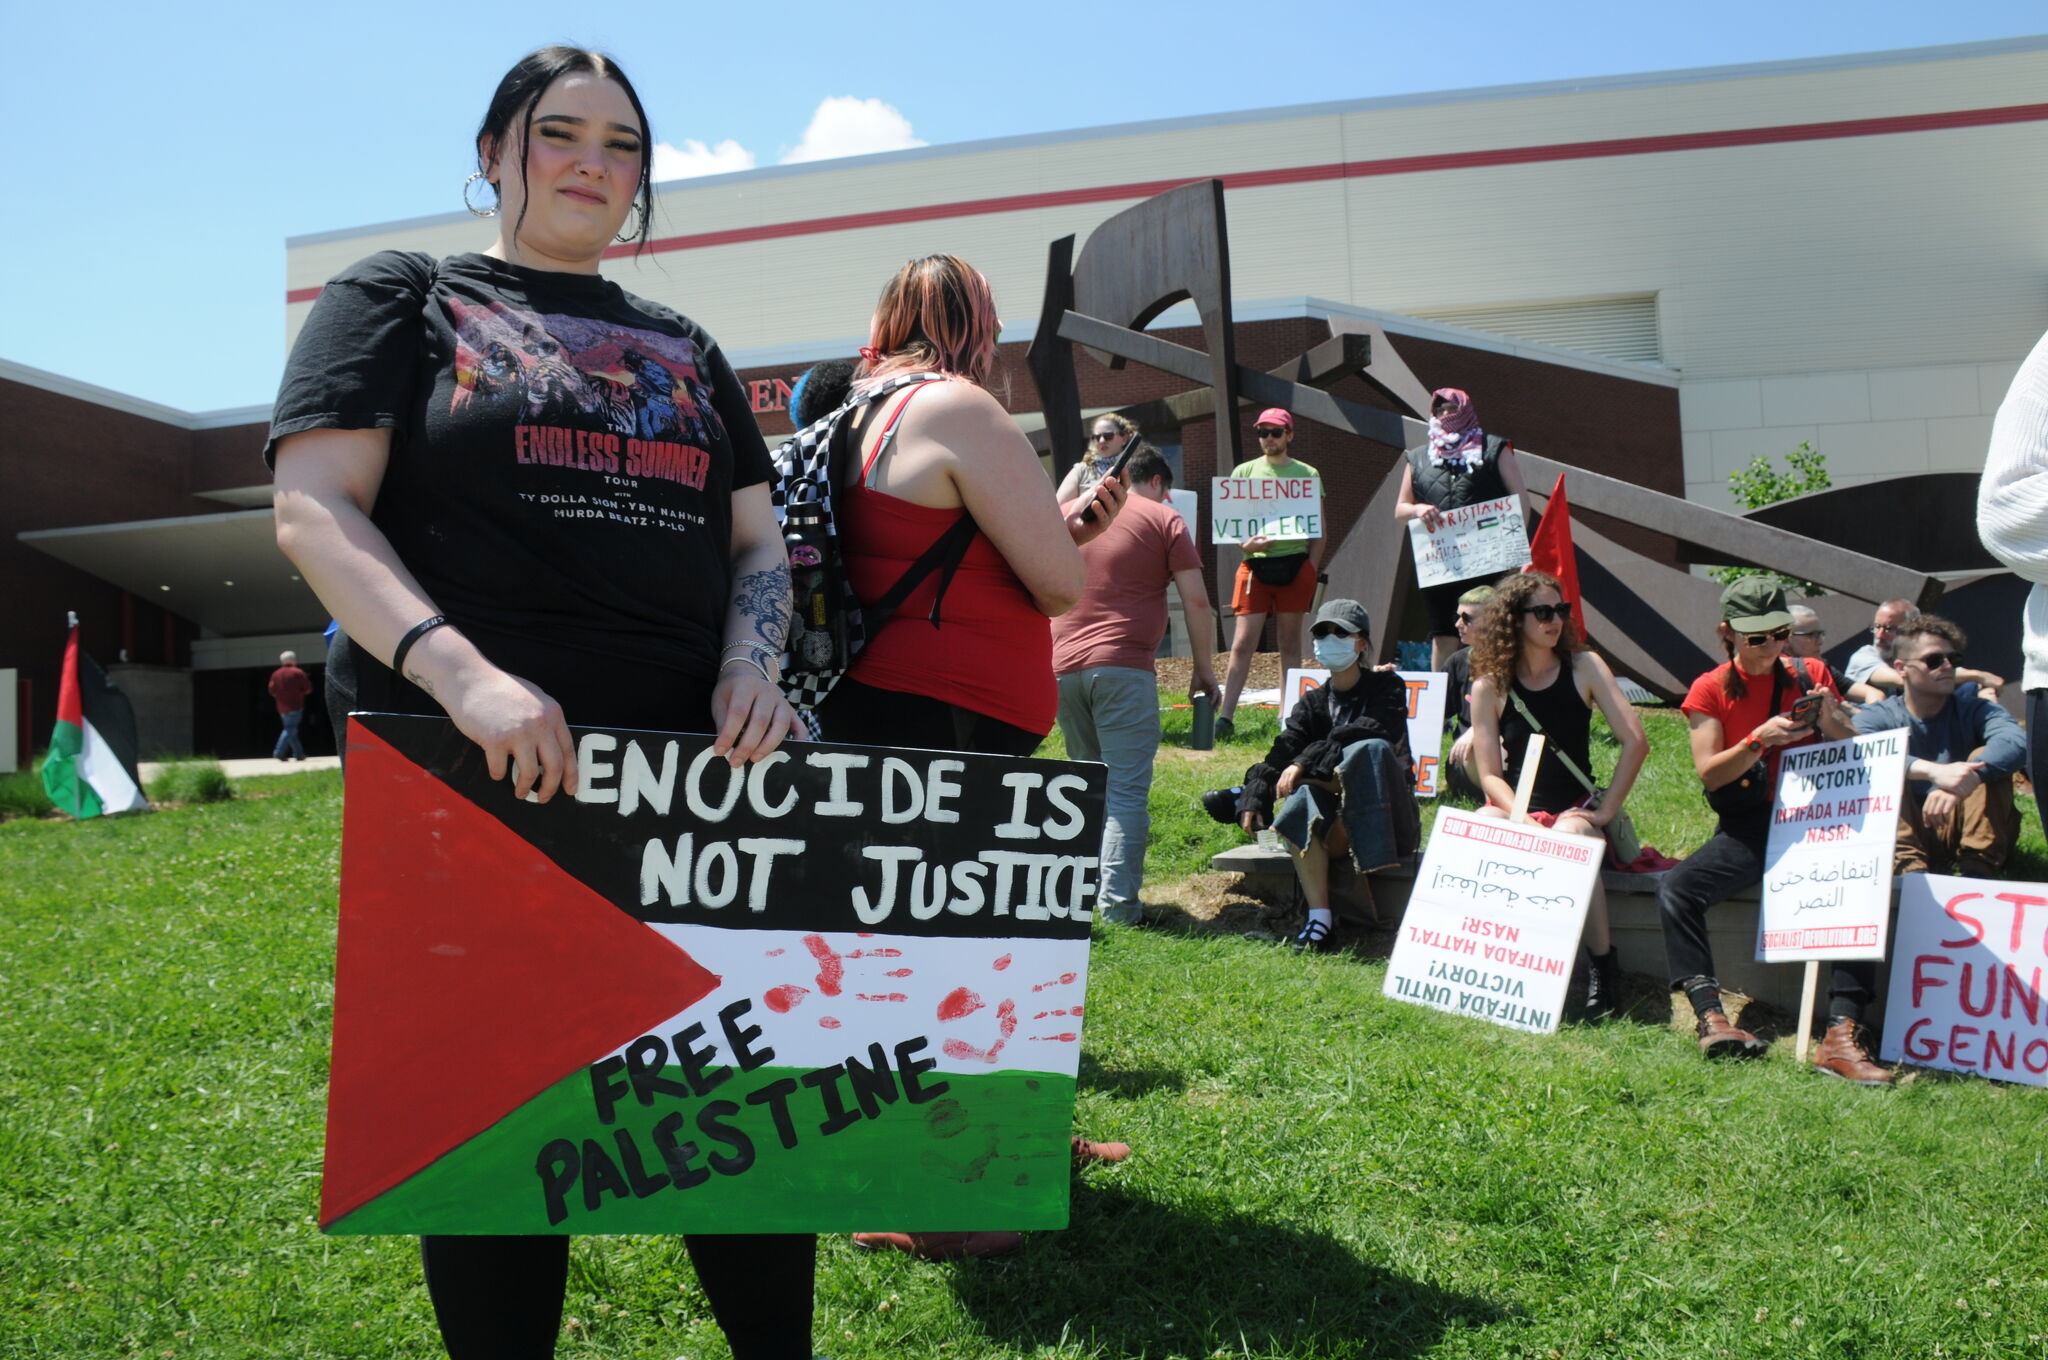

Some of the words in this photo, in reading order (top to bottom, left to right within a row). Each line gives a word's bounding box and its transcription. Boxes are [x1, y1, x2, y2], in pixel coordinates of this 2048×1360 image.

[514, 425, 619, 474] ENDLESS
[626, 438, 710, 492] SUMMER
[604, 476, 639, 488] TOUR
[1219, 480, 1313, 500] SILENCE
[519, 493, 535, 502] TY
[540, 494, 587, 504] DOLLA
[629, 502, 655, 513] YBN
[554, 509, 605, 519] MURDA
[608, 511, 648, 526] BEATZ
[1214, 514, 1319, 538] VIOLECE
[1781, 745, 1847, 773] INTIFADA
[1853, 737, 1899, 762] UNTIL
[1800, 766, 1873, 793] VICTORY!
[994, 771, 1089, 841] IS
[1774, 803, 1832, 825] INTIFADA
[1837, 795, 1893, 817] HATTA'L
[1806, 823, 1851, 843] NASR!
[639, 831, 806, 913] NOT
[851, 846, 1099, 925] JUSTICE
[1409, 926, 1477, 955] HATTA'L
[1462, 916, 1520, 943] NASR!
[1939, 892, 2048, 958] ST
[1484, 943, 1565, 976] INTIFADA
[1395, 975, 1451, 1005] UNTIL
[1429, 960, 1524, 998] VICTORY!
[1911, 954, 2048, 1027] FUN
[1460, 991, 1551, 1030] INTIFADA
[588, 998, 776, 1125] FREE
[535, 1035, 950, 1227] PALESTINE
